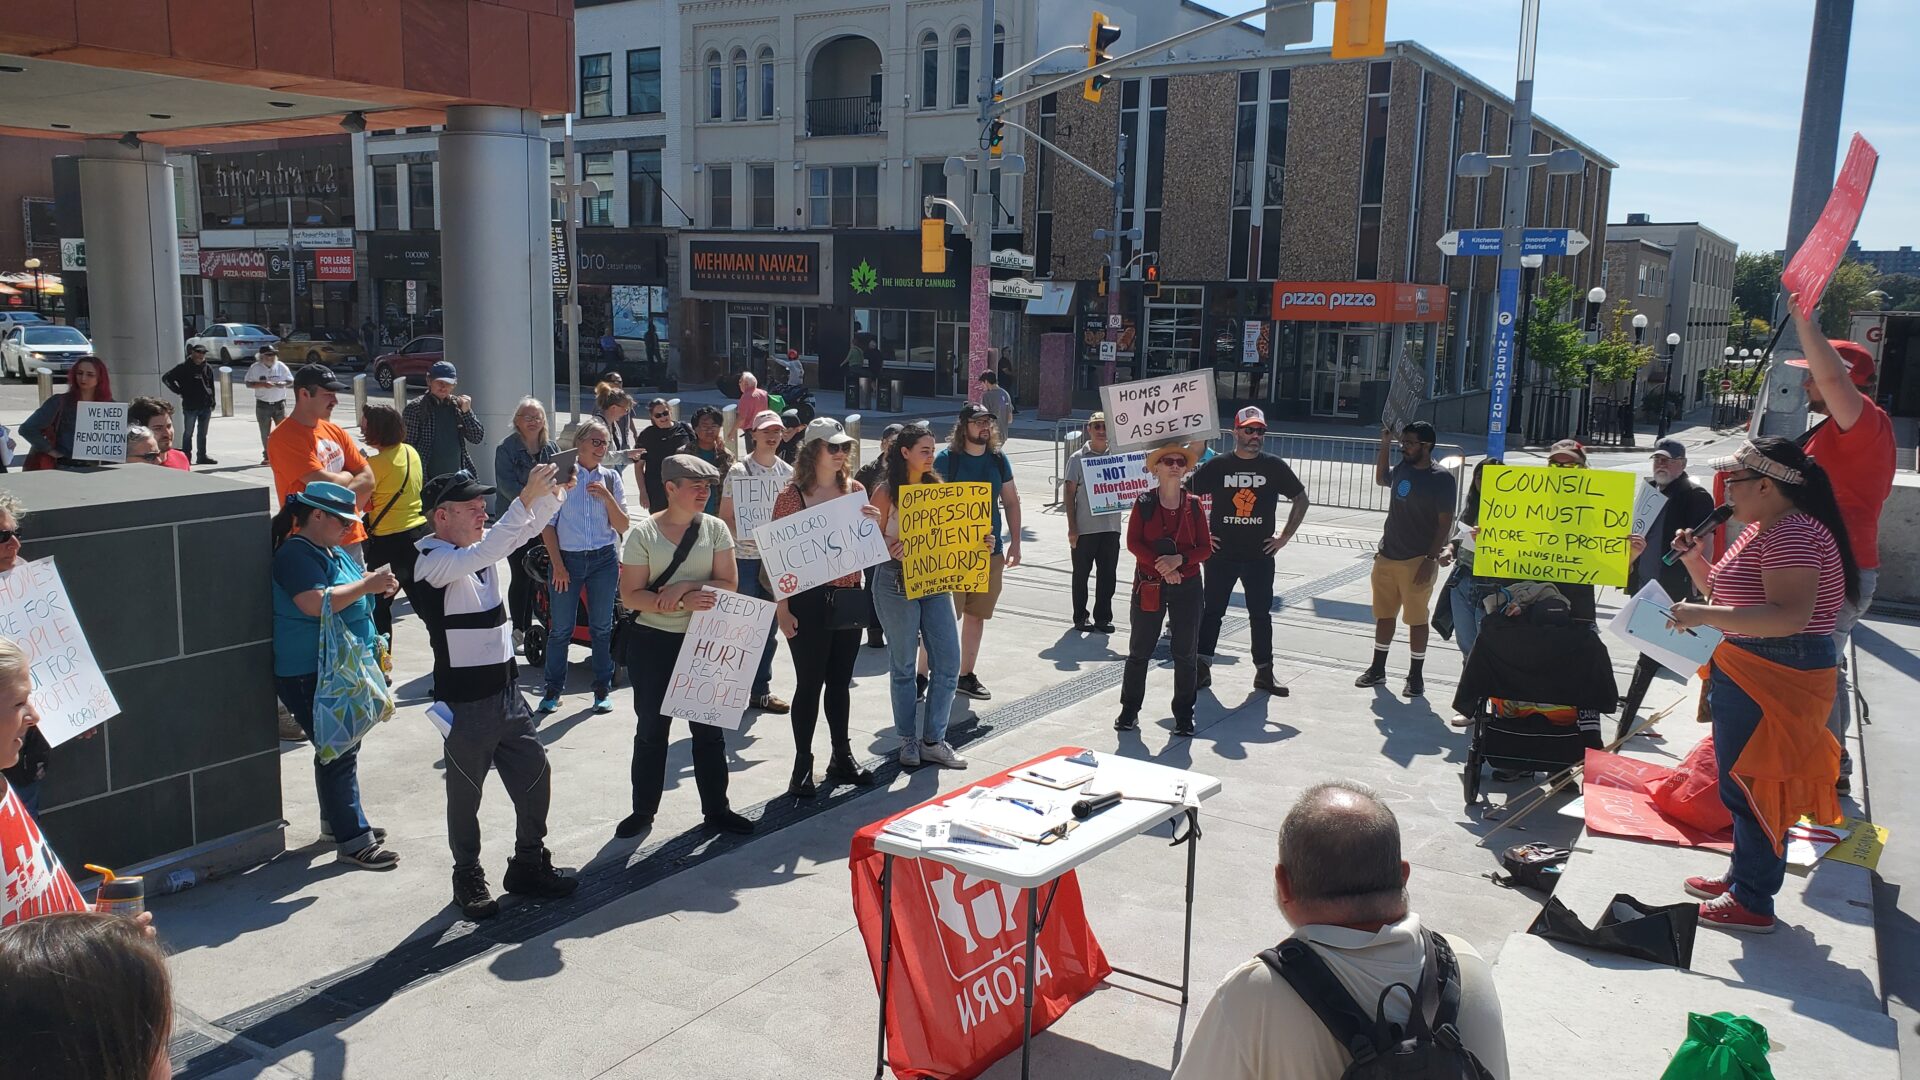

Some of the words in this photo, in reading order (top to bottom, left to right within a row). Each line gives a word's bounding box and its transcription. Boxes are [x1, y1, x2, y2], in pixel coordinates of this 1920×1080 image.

[319, 256, 332, 265] FOR
[332, 256, 351, 265] LEASE
[554, 226, 568, 285] KITCHENER
[694, 252, 755, 273] MEHMAN
[759, 253, 808, 273] NAVAZI
[995, 255, 1020, 265] GAUKEL
[731, 273, 765, 281] CUISINE
[882, 277, 893, 287] THE
[894, 278, 915, 287] HOUSE
[916, 278, 924, 287] OF
[925, 278, 956, 288] CANNABIS
[1002, 285, 1020, 294] KING
[1281, 292, 1326, 309] pizza
[1329, 293, 1376, 310] pizza
[1492, 331, 1508, 418] INFORMATION
[1118, 384, 1161, 402] HOMES
[1172, 379, 1199, 393] ARE
[87, 407, 102, 418] WE
[103, 407, 123, 418] NEED
[1143, 396, 1185, 417] NOT
[93, 420, 121, 431] BETTER
[1130, 413, 1204, 439] ASSETS
[76, 431, 126, 444] RENOVICTION
[86, 445, 123, 455] POLICIES
[1102, 466, 1126, 481] NOT
[1223, 475, 1267, 488] NDP
[1495, 470, 1605, 497] COUNSIL
[902, 486, 964, 509] OPPOSED
[969, 485, 989, 496] TO
[1093, 478, 1149, 495] Affordable
[902, 501, 991, 534] OPPRESSION
[1223, 515, 1263, 525] STRONG
[1483, 498, 1517, 520] YOU
[1525, 504, 1595, 526] MUST
[1604, 508, 1630, 528] DO
[756, 514, 828, 551] LANDLORD
[902, 524, 987, 558] OPPULENT
[931, 528, 941, 536] BY
[1482, 527, 1527, 543] MORE
[1532, 531, 1559, 546] TO
[1565, 534, 1630, 557] PROTECT
[765, 517, 874, 578] LICENSING
[1478, 546, 1505, 557] THE
[1518, 550, 1584, 565] INVISIBLE
[826, 541, 881, 578] NOW!
[905, 550, 988, 580] LANDLORDS
[1494, 559, 1600, 585] MINORITY!
[910, 581, 923, 593] WHY
[925, 577, 937, 587] THE
[939, 574, 965, 584] NEED
[922, 585, 935, 595] FOR
[936, 582, 979, 592] GREED?
[24, 590, 65, 624] FOR
[46, 646, 81, 682] FOR
[694, 638, 753, 671] HURT
[688, 658, 739, 682] REAL
[670, 707, 699, 720] ACORN
